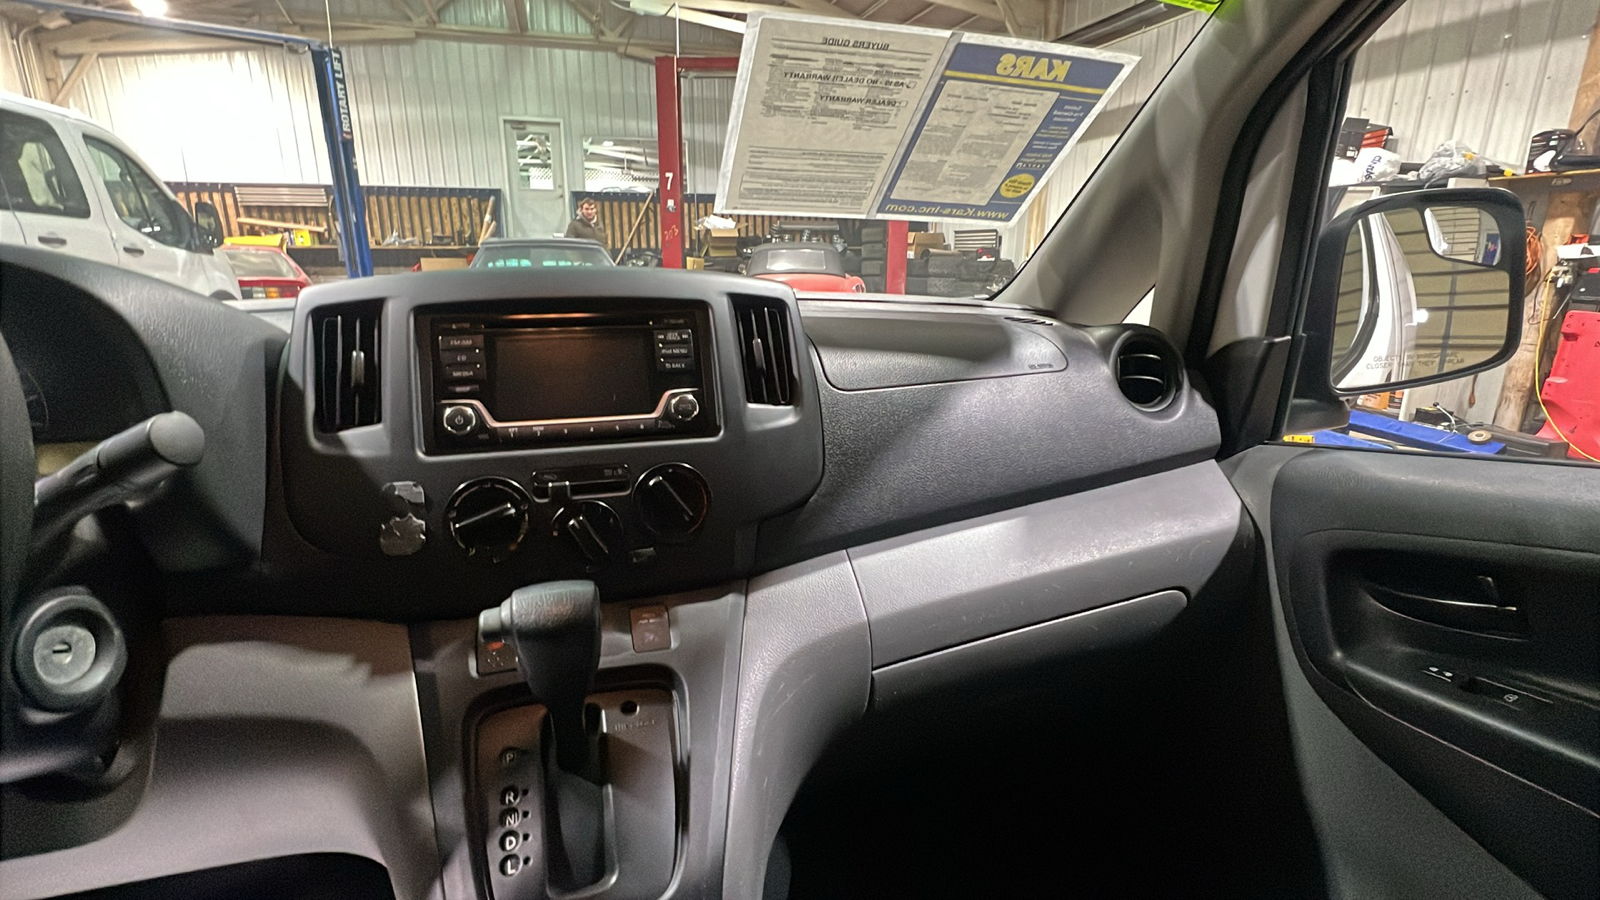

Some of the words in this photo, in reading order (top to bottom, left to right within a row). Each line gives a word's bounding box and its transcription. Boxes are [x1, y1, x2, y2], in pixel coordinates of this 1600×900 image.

[331, 51, 343, 79] LIFT
[336, 80, 351, 132] ROTARY
[665, 172, 673, 190] 7
[505, 753, 514, 762] P
[505, 792, 515, 803] R
[505, 814, 517, 825] N
[505, 836, 516, 848] D
[507, 859, 516, 873] L
